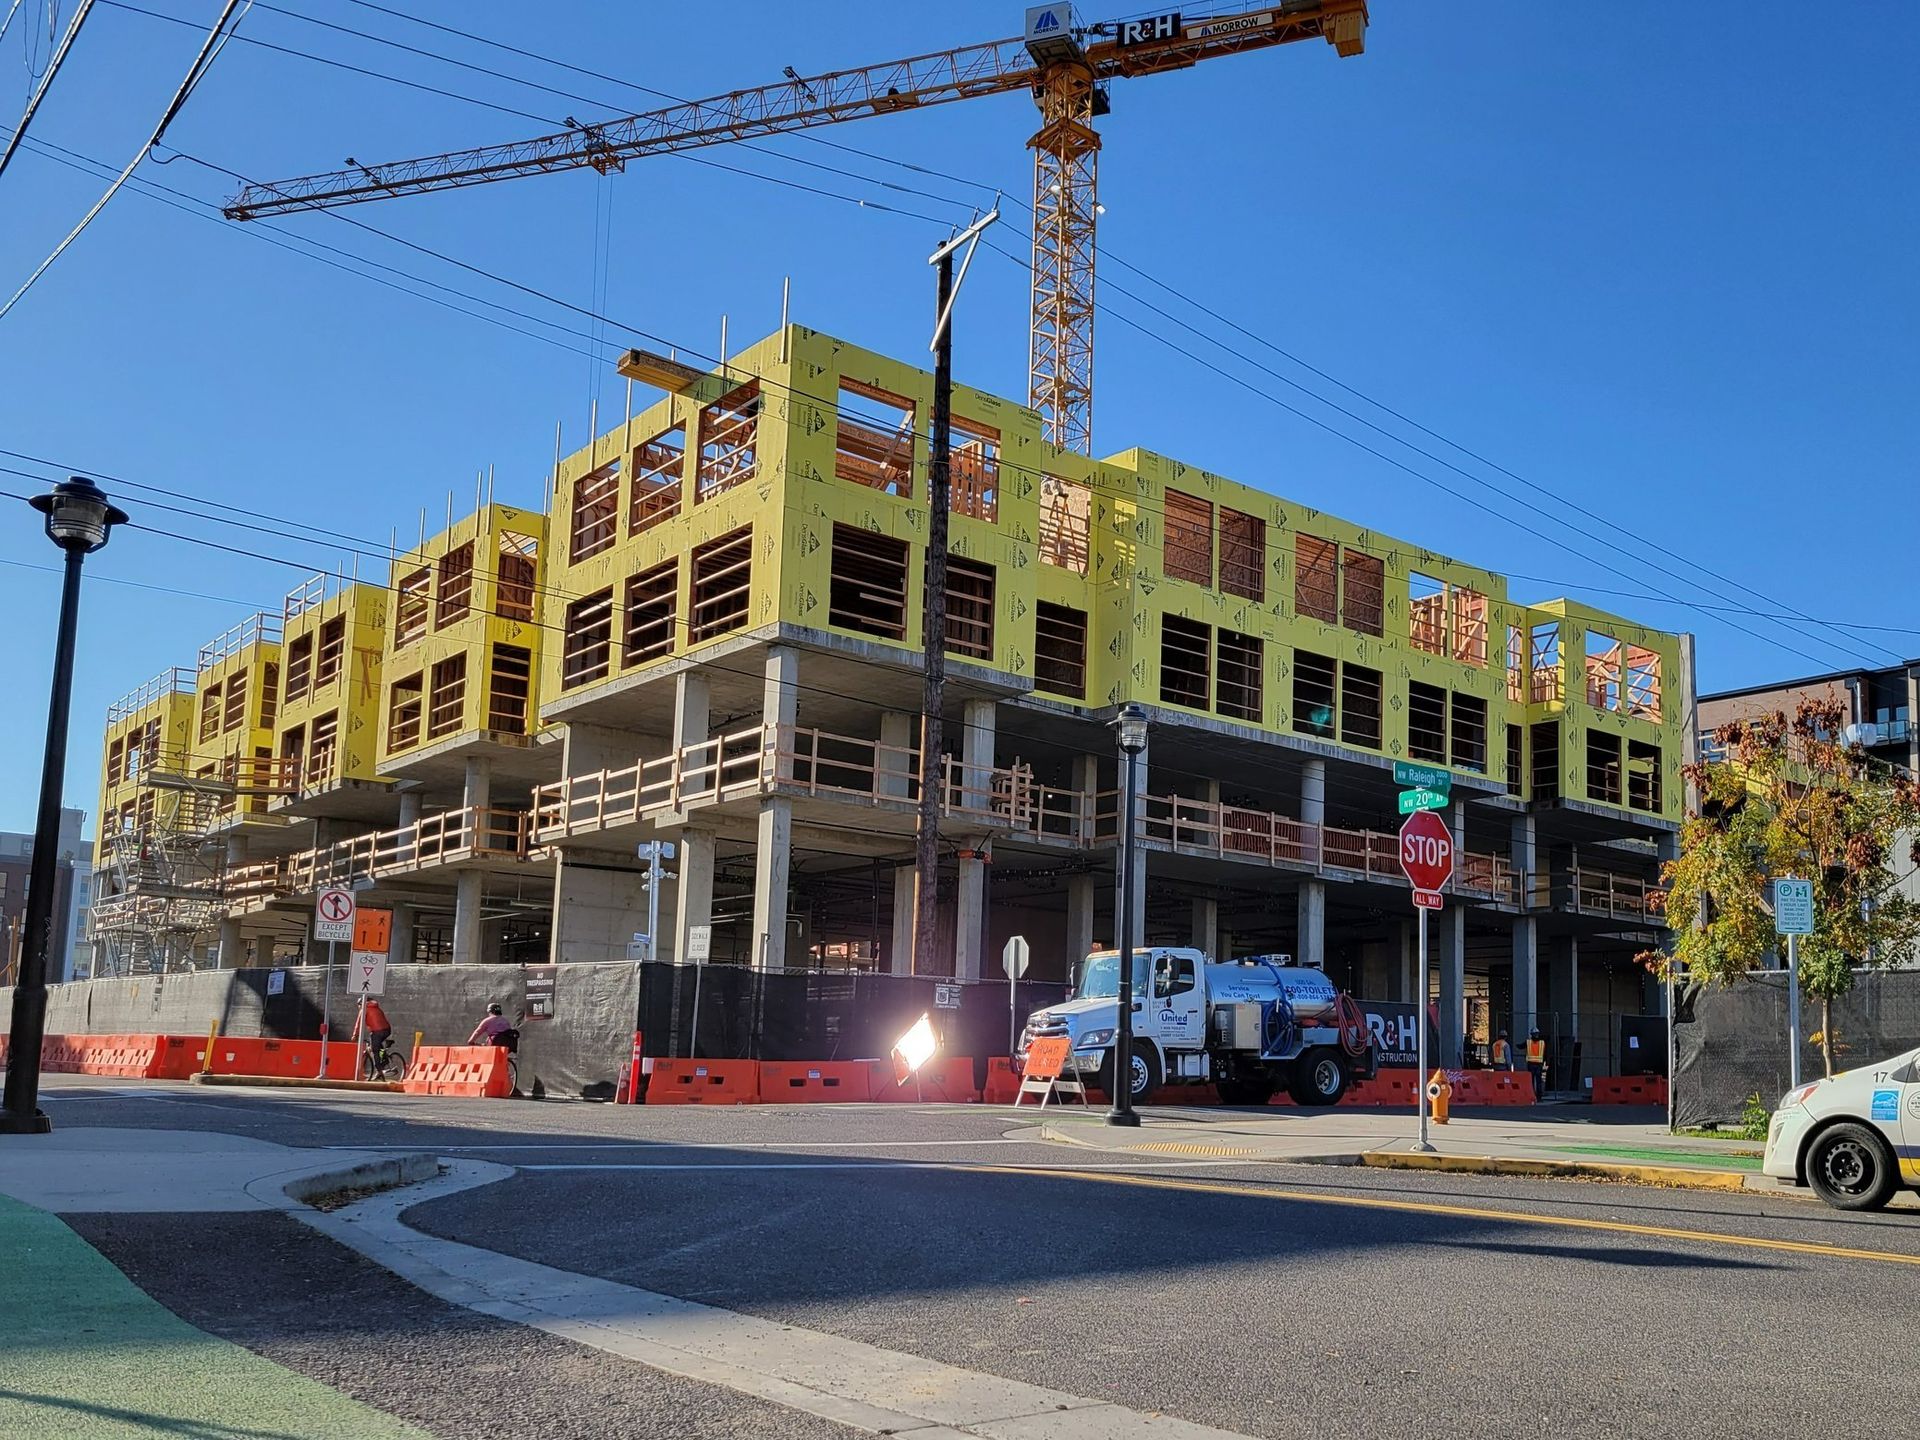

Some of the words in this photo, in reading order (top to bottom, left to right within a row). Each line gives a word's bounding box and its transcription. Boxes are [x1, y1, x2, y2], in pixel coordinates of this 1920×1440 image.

[1124, 15, 1173, 45] R&H
[1213, 17, 1259, 33] MORROW
[1409, 768, 1436, 787] Raleigh
[1403, 799, 1414, 808] NW
[1436, 794, 1444, 803] AV
[1404, 833, 1449, 868] STOP
[1415, 893, 1427, 905] ALL
[1428, 895, 1440, 906] WAY
[322, 923, 347, 931] EXCEPT
[317, 930, 350, 939] BICYCLES
[1228, 984, 1251, 992] Service
[1233, 991, 1245, 999] Can
[1161, 1013, 1188, 1023] United
[1366, 1013, 1417, 1051] R&H
[1377, 1052, 1418, 1063] NSTRUCTION
[1873, 1071, 1888, 1084] 17
